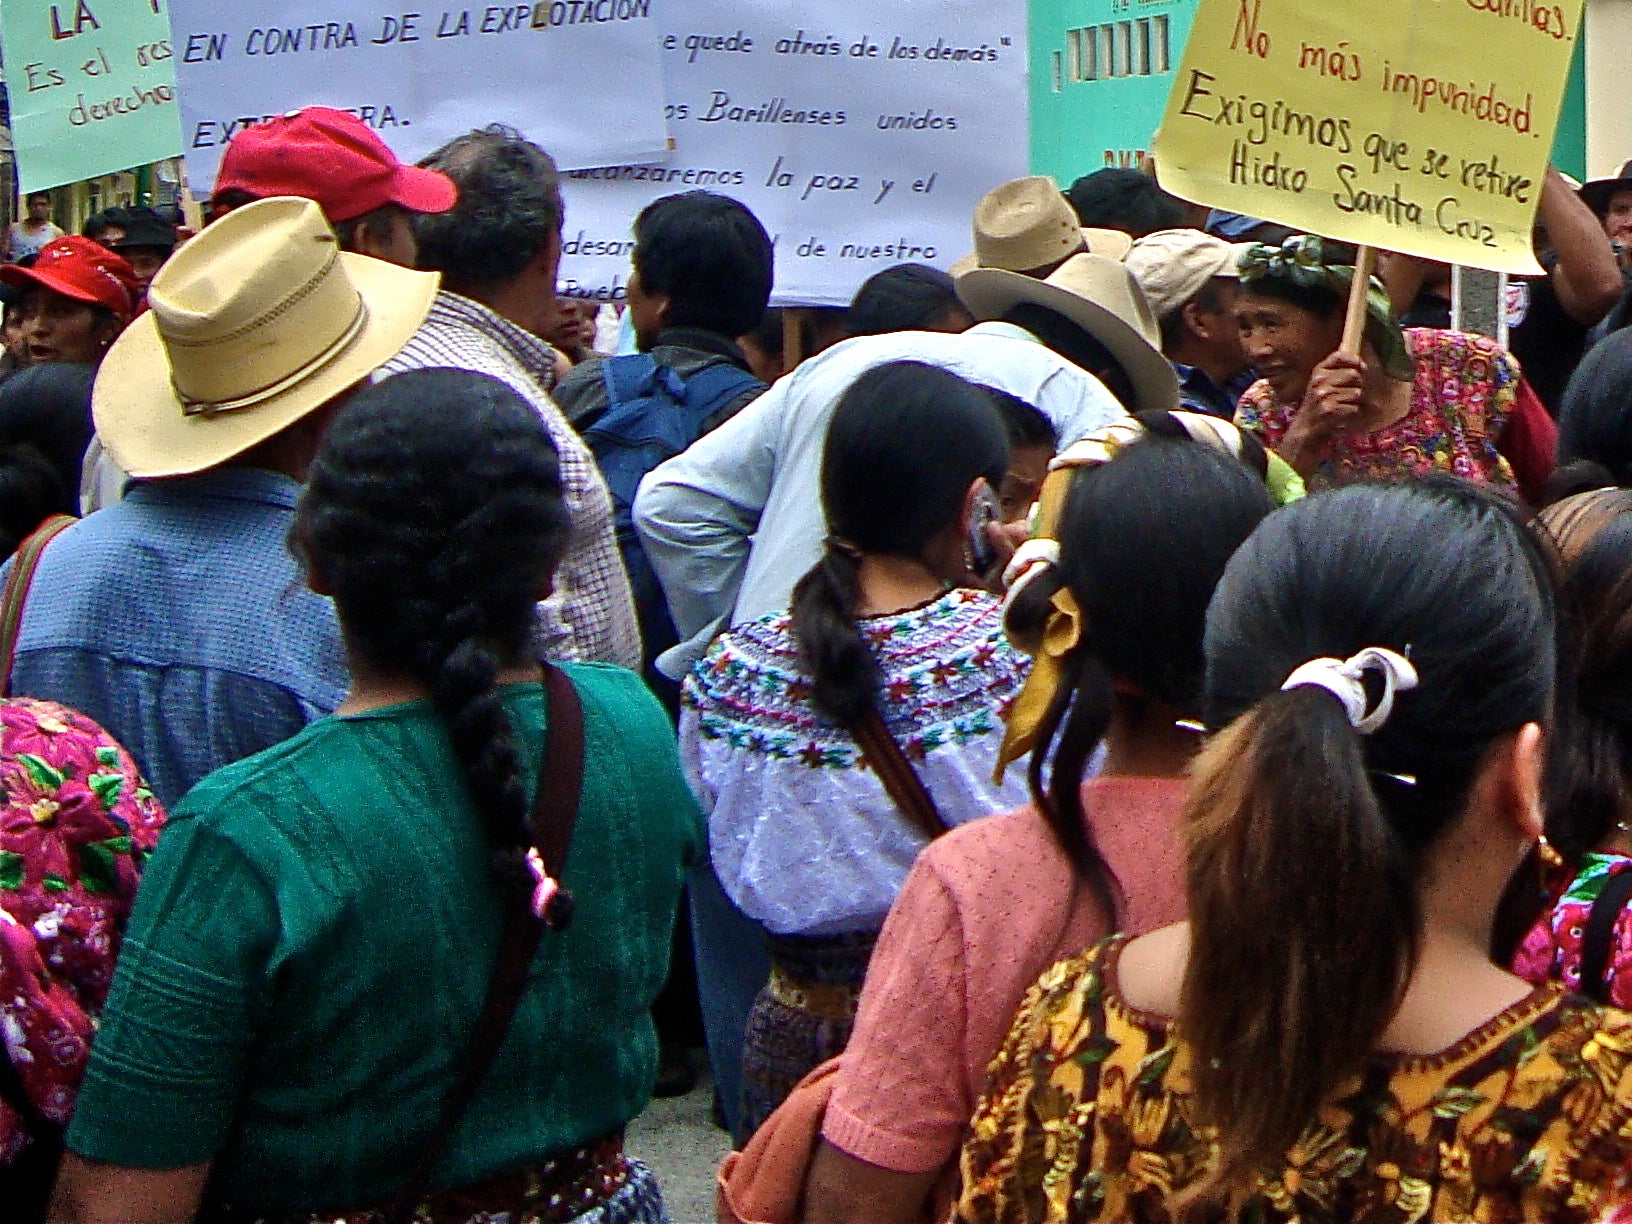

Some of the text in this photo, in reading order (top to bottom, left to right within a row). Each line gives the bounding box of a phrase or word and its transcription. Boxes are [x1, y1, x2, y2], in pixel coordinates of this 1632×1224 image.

[183, 32, 226, 64] EN
[245, 19, 359, 55] CONTRA
[372, 11, 421, 46] DE
[437, 9, 470, 38] LA
[662, 34, 677, 50] e
[684, 30, 753, 64] quede
[774, 30, 842, 56] atrás
[850, 34, 878, 59] de
[888, 37, 919, 60] los
[24, 40, 173, 92] Es el res
[1299, 39, 1361, 82] más
[1382, 60, 1541, 139] impunidad.
[69, 85, 175, 126] derecho
[664, 91, 958, 131] os Barillenses unidos
[1179, 69, 1531, 203] Exigimos que se retire
[766, 156, 795, 187] la
[802, 174, 859, 203] paz
[873, 177, 895, 204] y
[912, 172, 937, 194] el
[1229, 138, 1498, 247] Hidro Santa Cruz
[563, 230, 938, 260] desar de nuestro
[557, 275, 628, 301] Pueb
